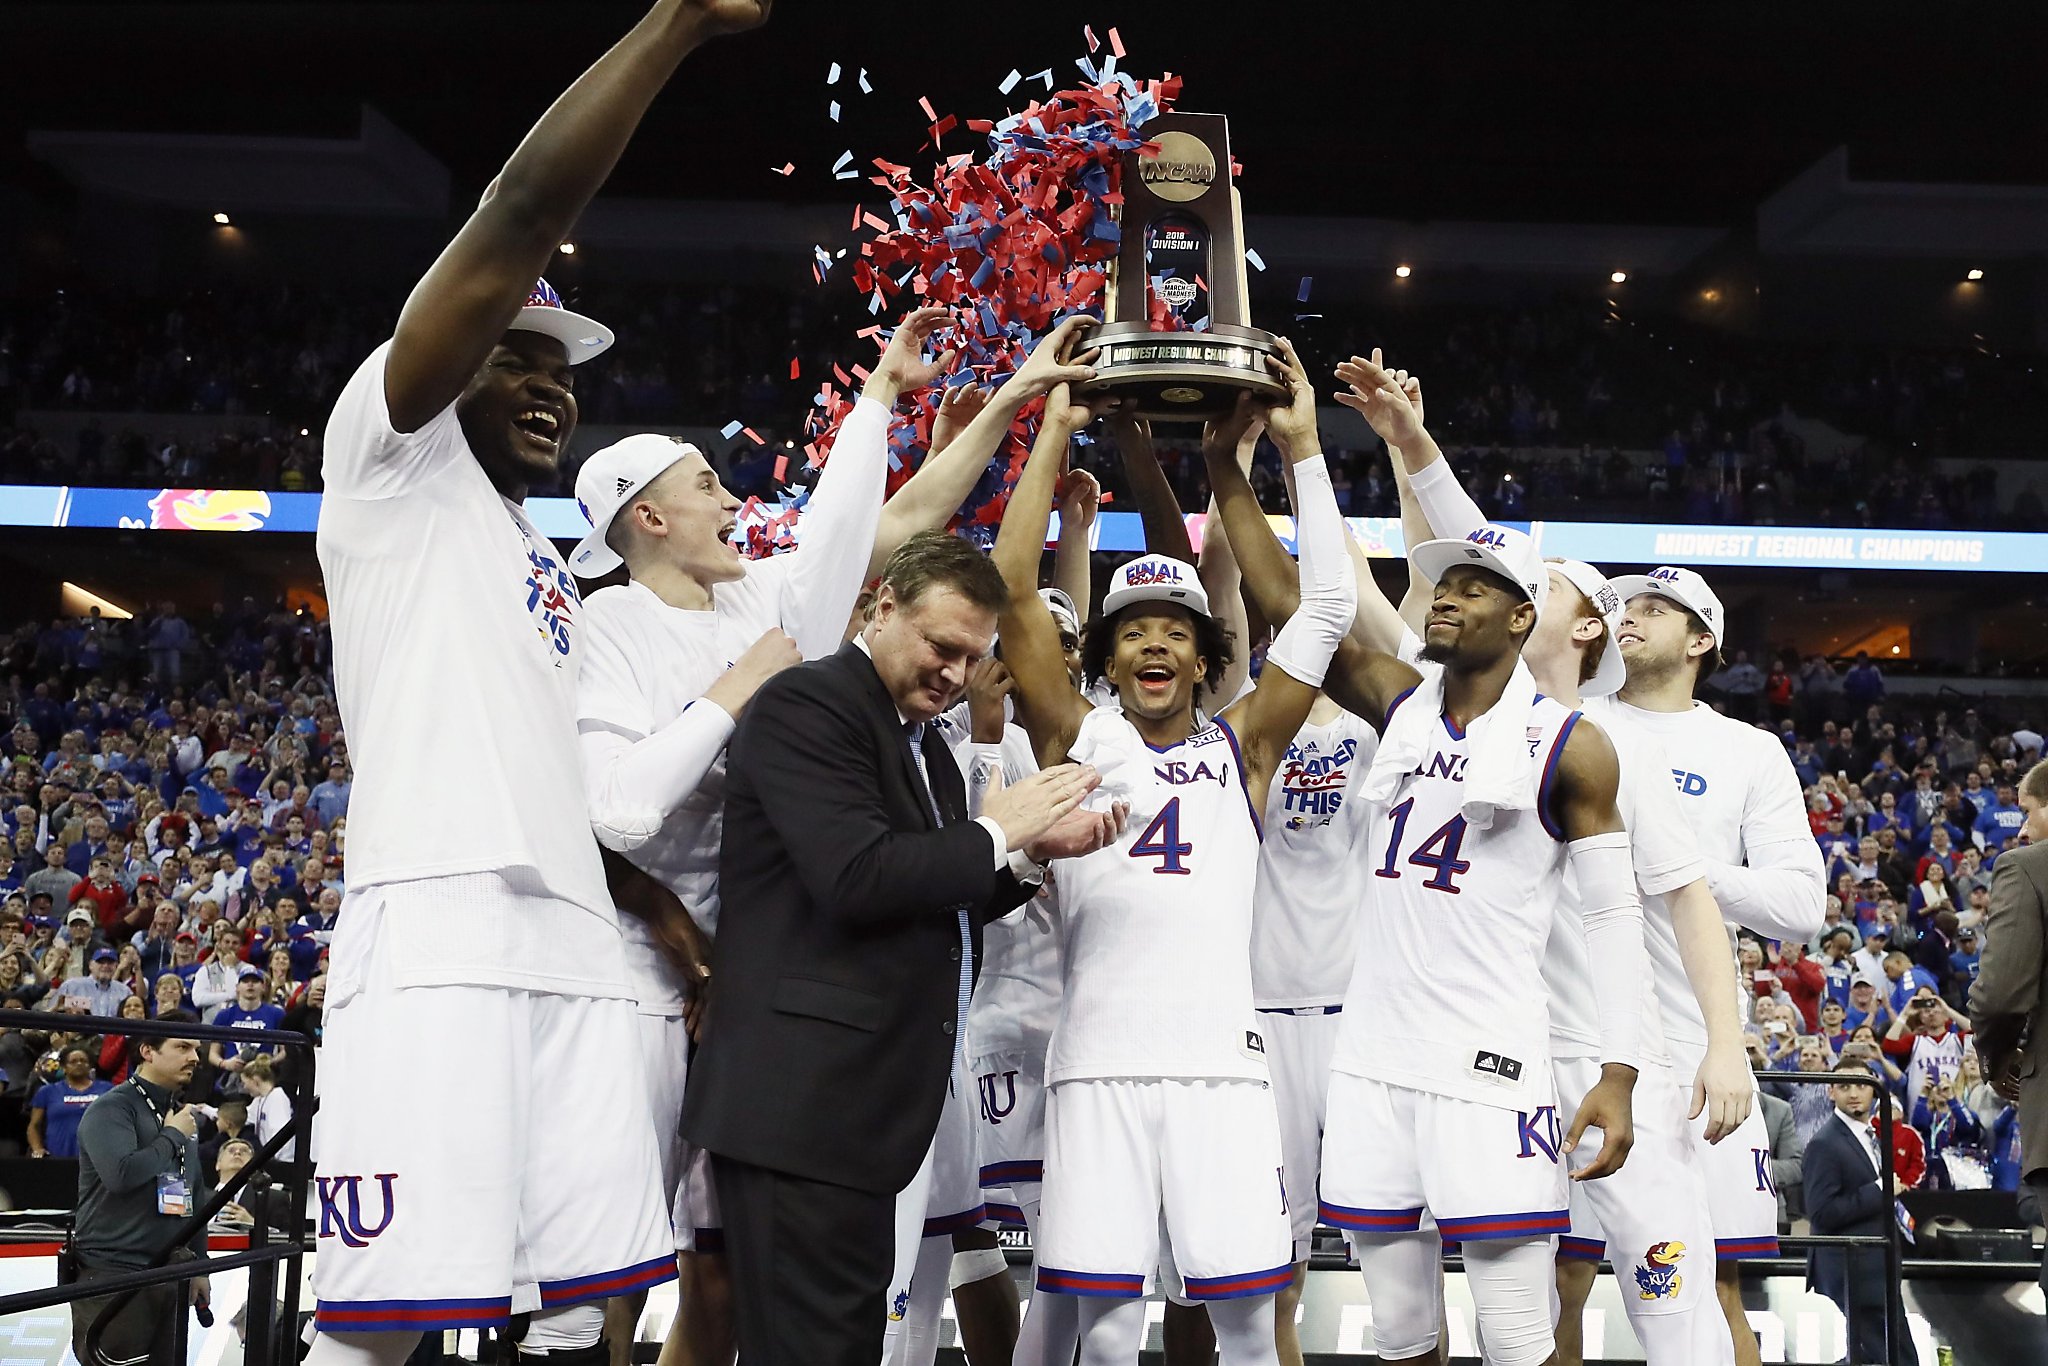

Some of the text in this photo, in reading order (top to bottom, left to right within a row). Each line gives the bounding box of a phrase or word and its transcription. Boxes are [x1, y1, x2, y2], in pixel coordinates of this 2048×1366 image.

[1144, 161, 1214, 184] NCAA
[1152, 239, 1195, 250] DIVISION
[1165, 231, 1186, 240] 2018
[1166, 290, 1196, 298] MADNESS
[1112, 346, 1158, 362] MIDWEST
[1158, 346, 1203, 360] REGIONAL
[1465, 528, 1506, 548] NAL
[1653, 533, 1984, 563] MIDWEST REGIONAL CHAMPIONS
[1281, 786, 1343, 815] THIS
[1128, 796, 1193, 875] 4
[1374, 796, 1471, 895] 14
[977, 1070, 1019, 1125] KU
[315, 1173, 399, 1248] KU
[1649, 1272, 1667, 1286] KU
